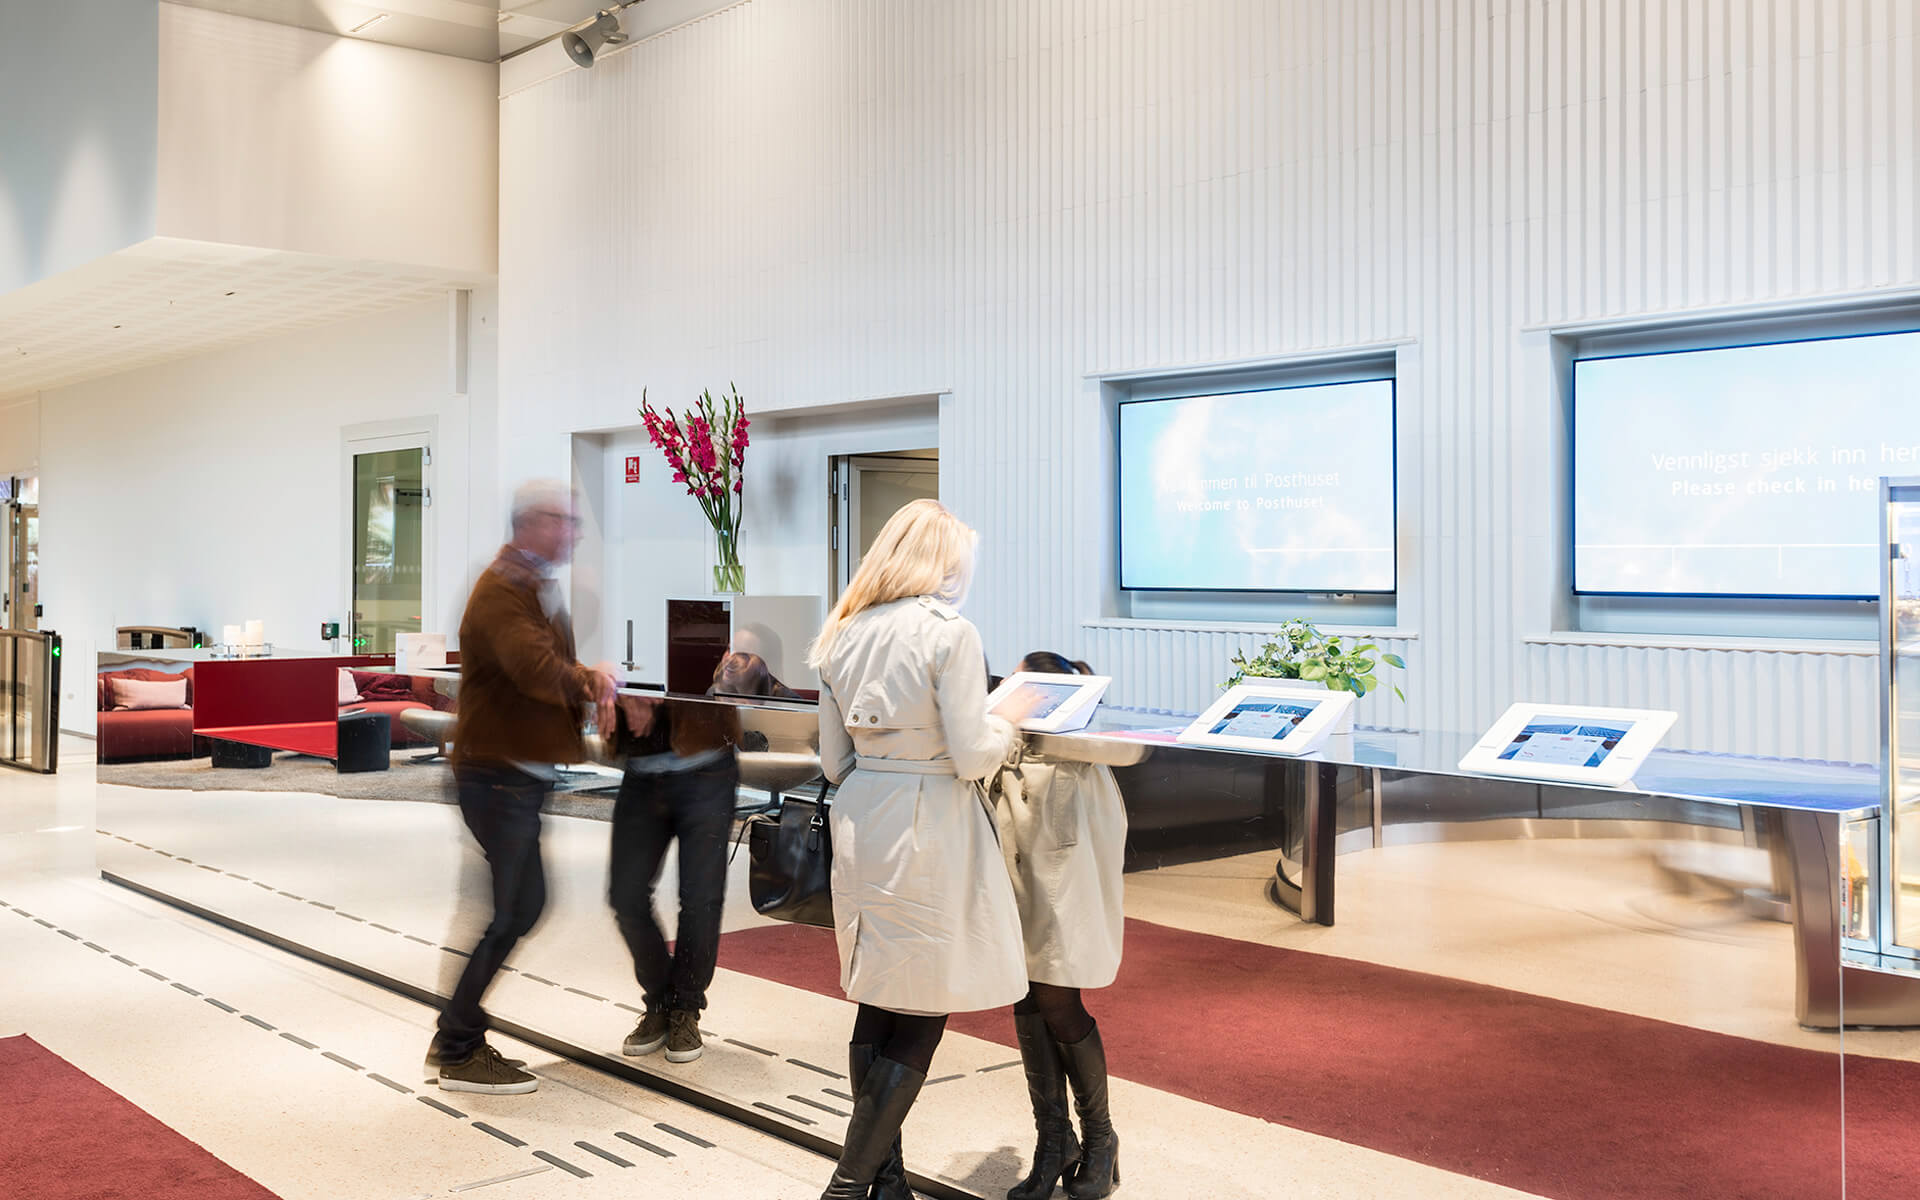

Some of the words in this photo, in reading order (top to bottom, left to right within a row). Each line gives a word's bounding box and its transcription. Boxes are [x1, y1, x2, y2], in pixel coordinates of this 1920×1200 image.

[1650, 449, 1751, 474] Vennligst
[1760, 446, 1820, 471] sjekk
[1831, 446, 1866, 464] inn
[1244, 474, 1257, 489] til
[1265, 471, 1340, 488] Posthuset
[1671, 479, 1736, 496] Please
[1747, 476, 1806, 494] check
[1817, 476, 1836, 492] in
[1849, 475, 1877, 491] he
[1176, 497, 1232, 512] Welcome
[1237, 497, 1250, 511] to
[1256, 494, 1325, 510] Posthuset
